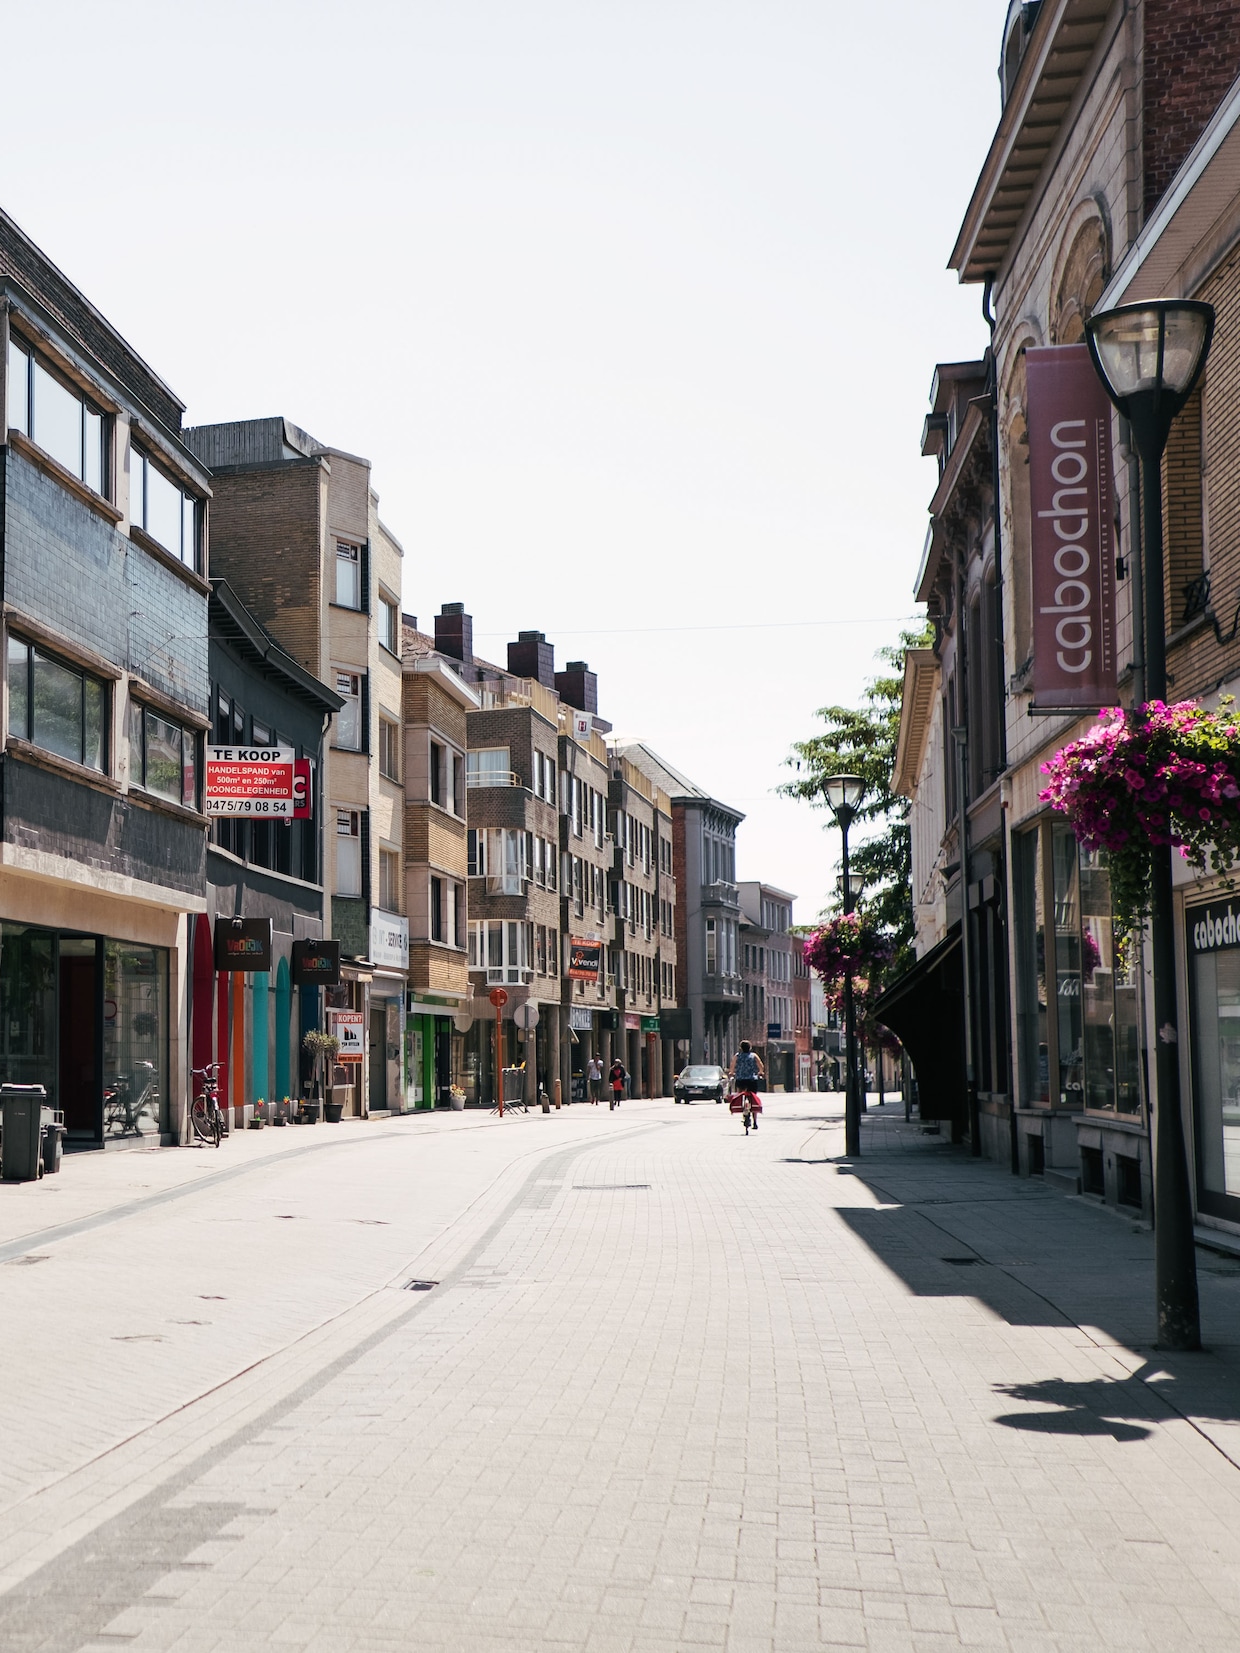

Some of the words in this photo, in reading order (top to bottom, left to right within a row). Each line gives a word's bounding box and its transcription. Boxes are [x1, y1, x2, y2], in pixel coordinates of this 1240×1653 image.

[1037, 419, 1092, 673] cabochon
[213, 750, 232, 760] TE
[238, 750, 281, 762] KOOP
[208, 766, 269, 775] HANDELSPAND
[207, 786, 288, 795] WOONGELEGENHEID
[207, 800, 251, 811] 0475/79
[255, 801, 269, 811] 08
[273, 802, 286, 812] 54
[338, 1014, 362, 1023] KOPEN?
